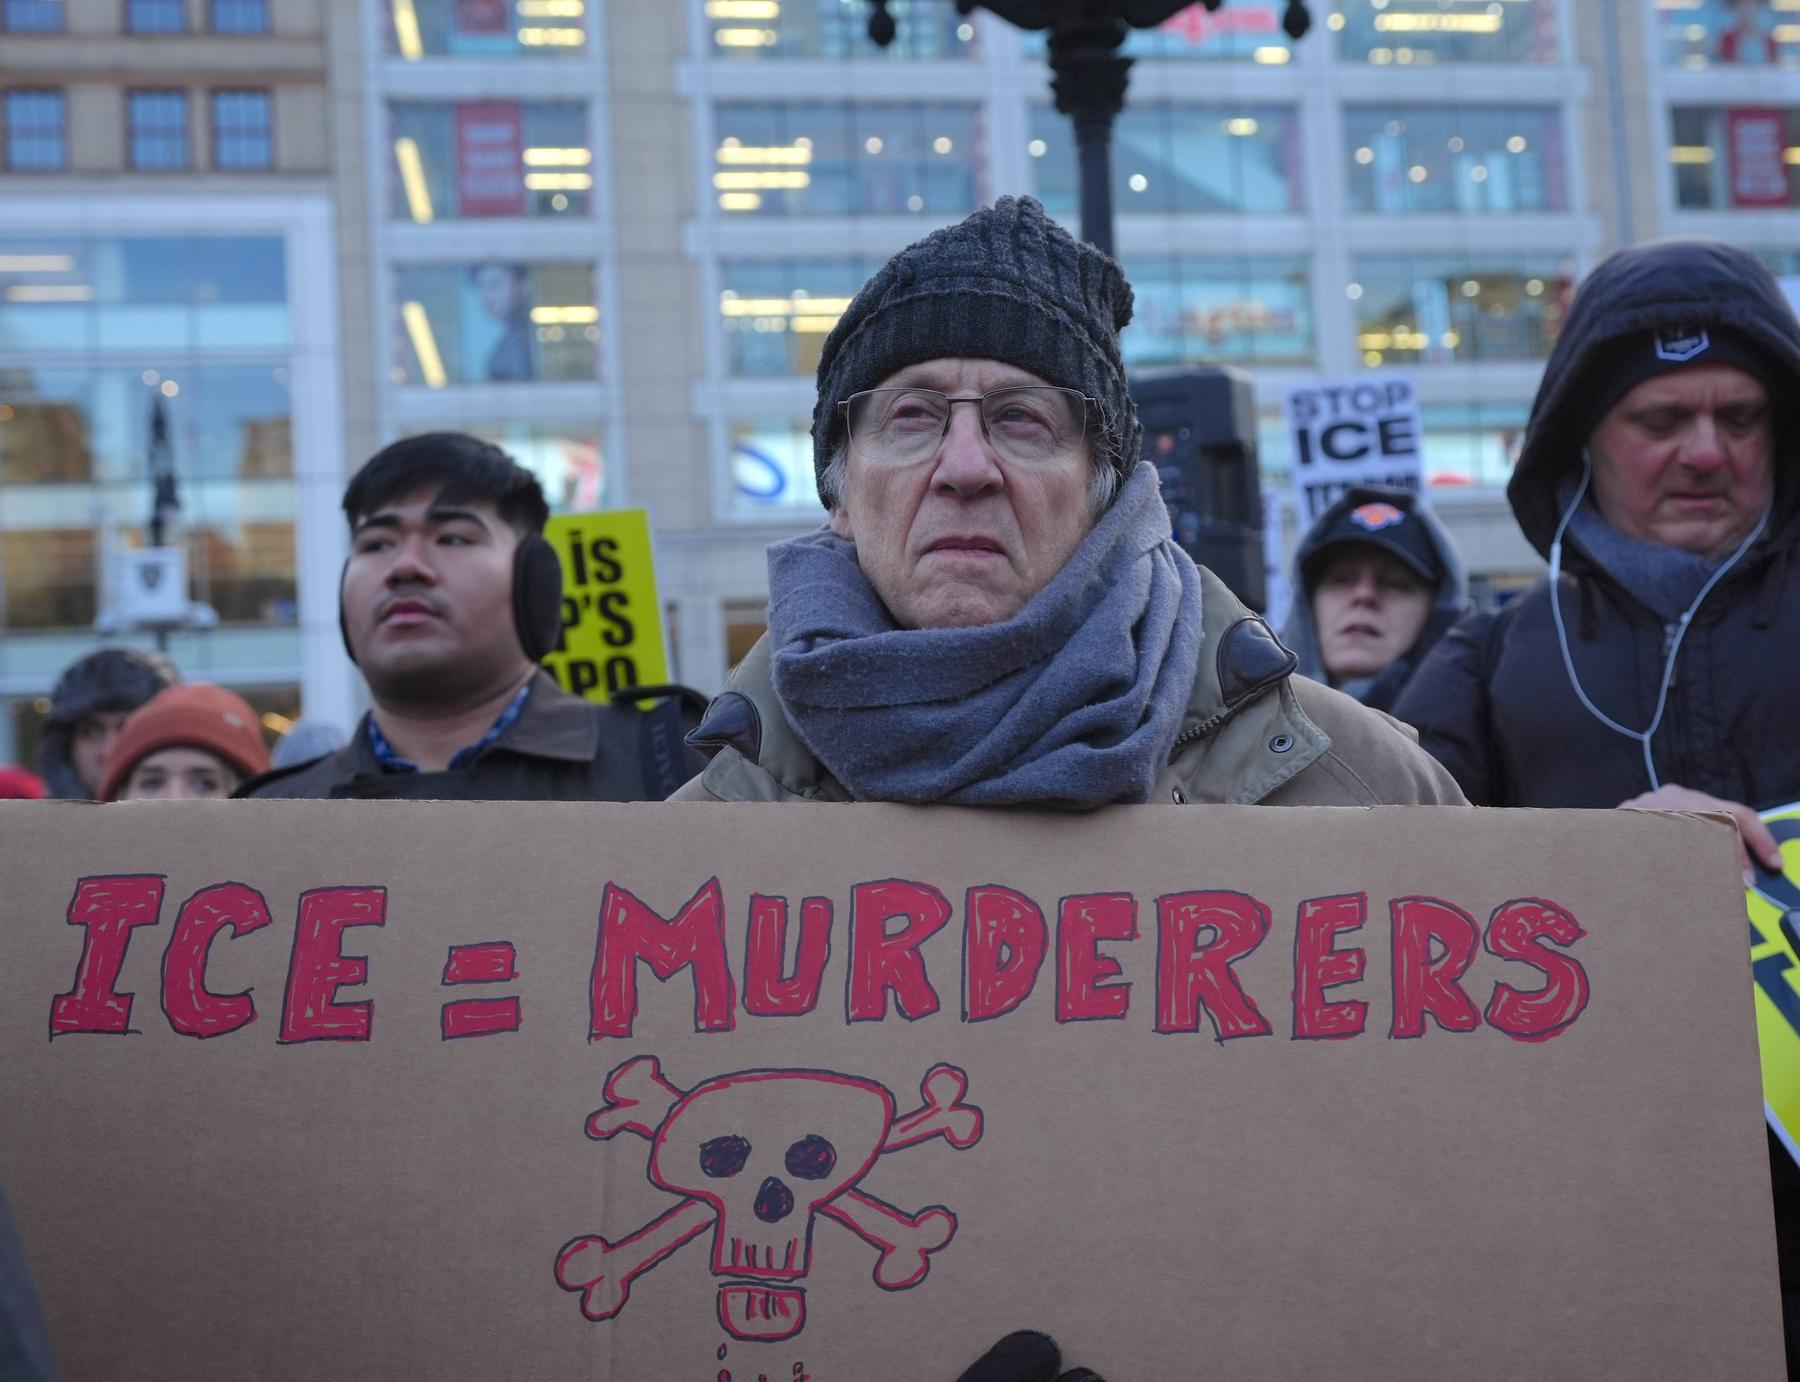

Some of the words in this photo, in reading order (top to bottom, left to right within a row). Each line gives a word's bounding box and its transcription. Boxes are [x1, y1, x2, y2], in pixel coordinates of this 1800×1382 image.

[1291, 381, 1411, 417] STOP
[1298, 417, 1416, 464] ICE
[49, 873, 388, 1045] ICE
[441, 941, 522, 1041] =
[587, 875, 1590, 1046] MURDERERS
